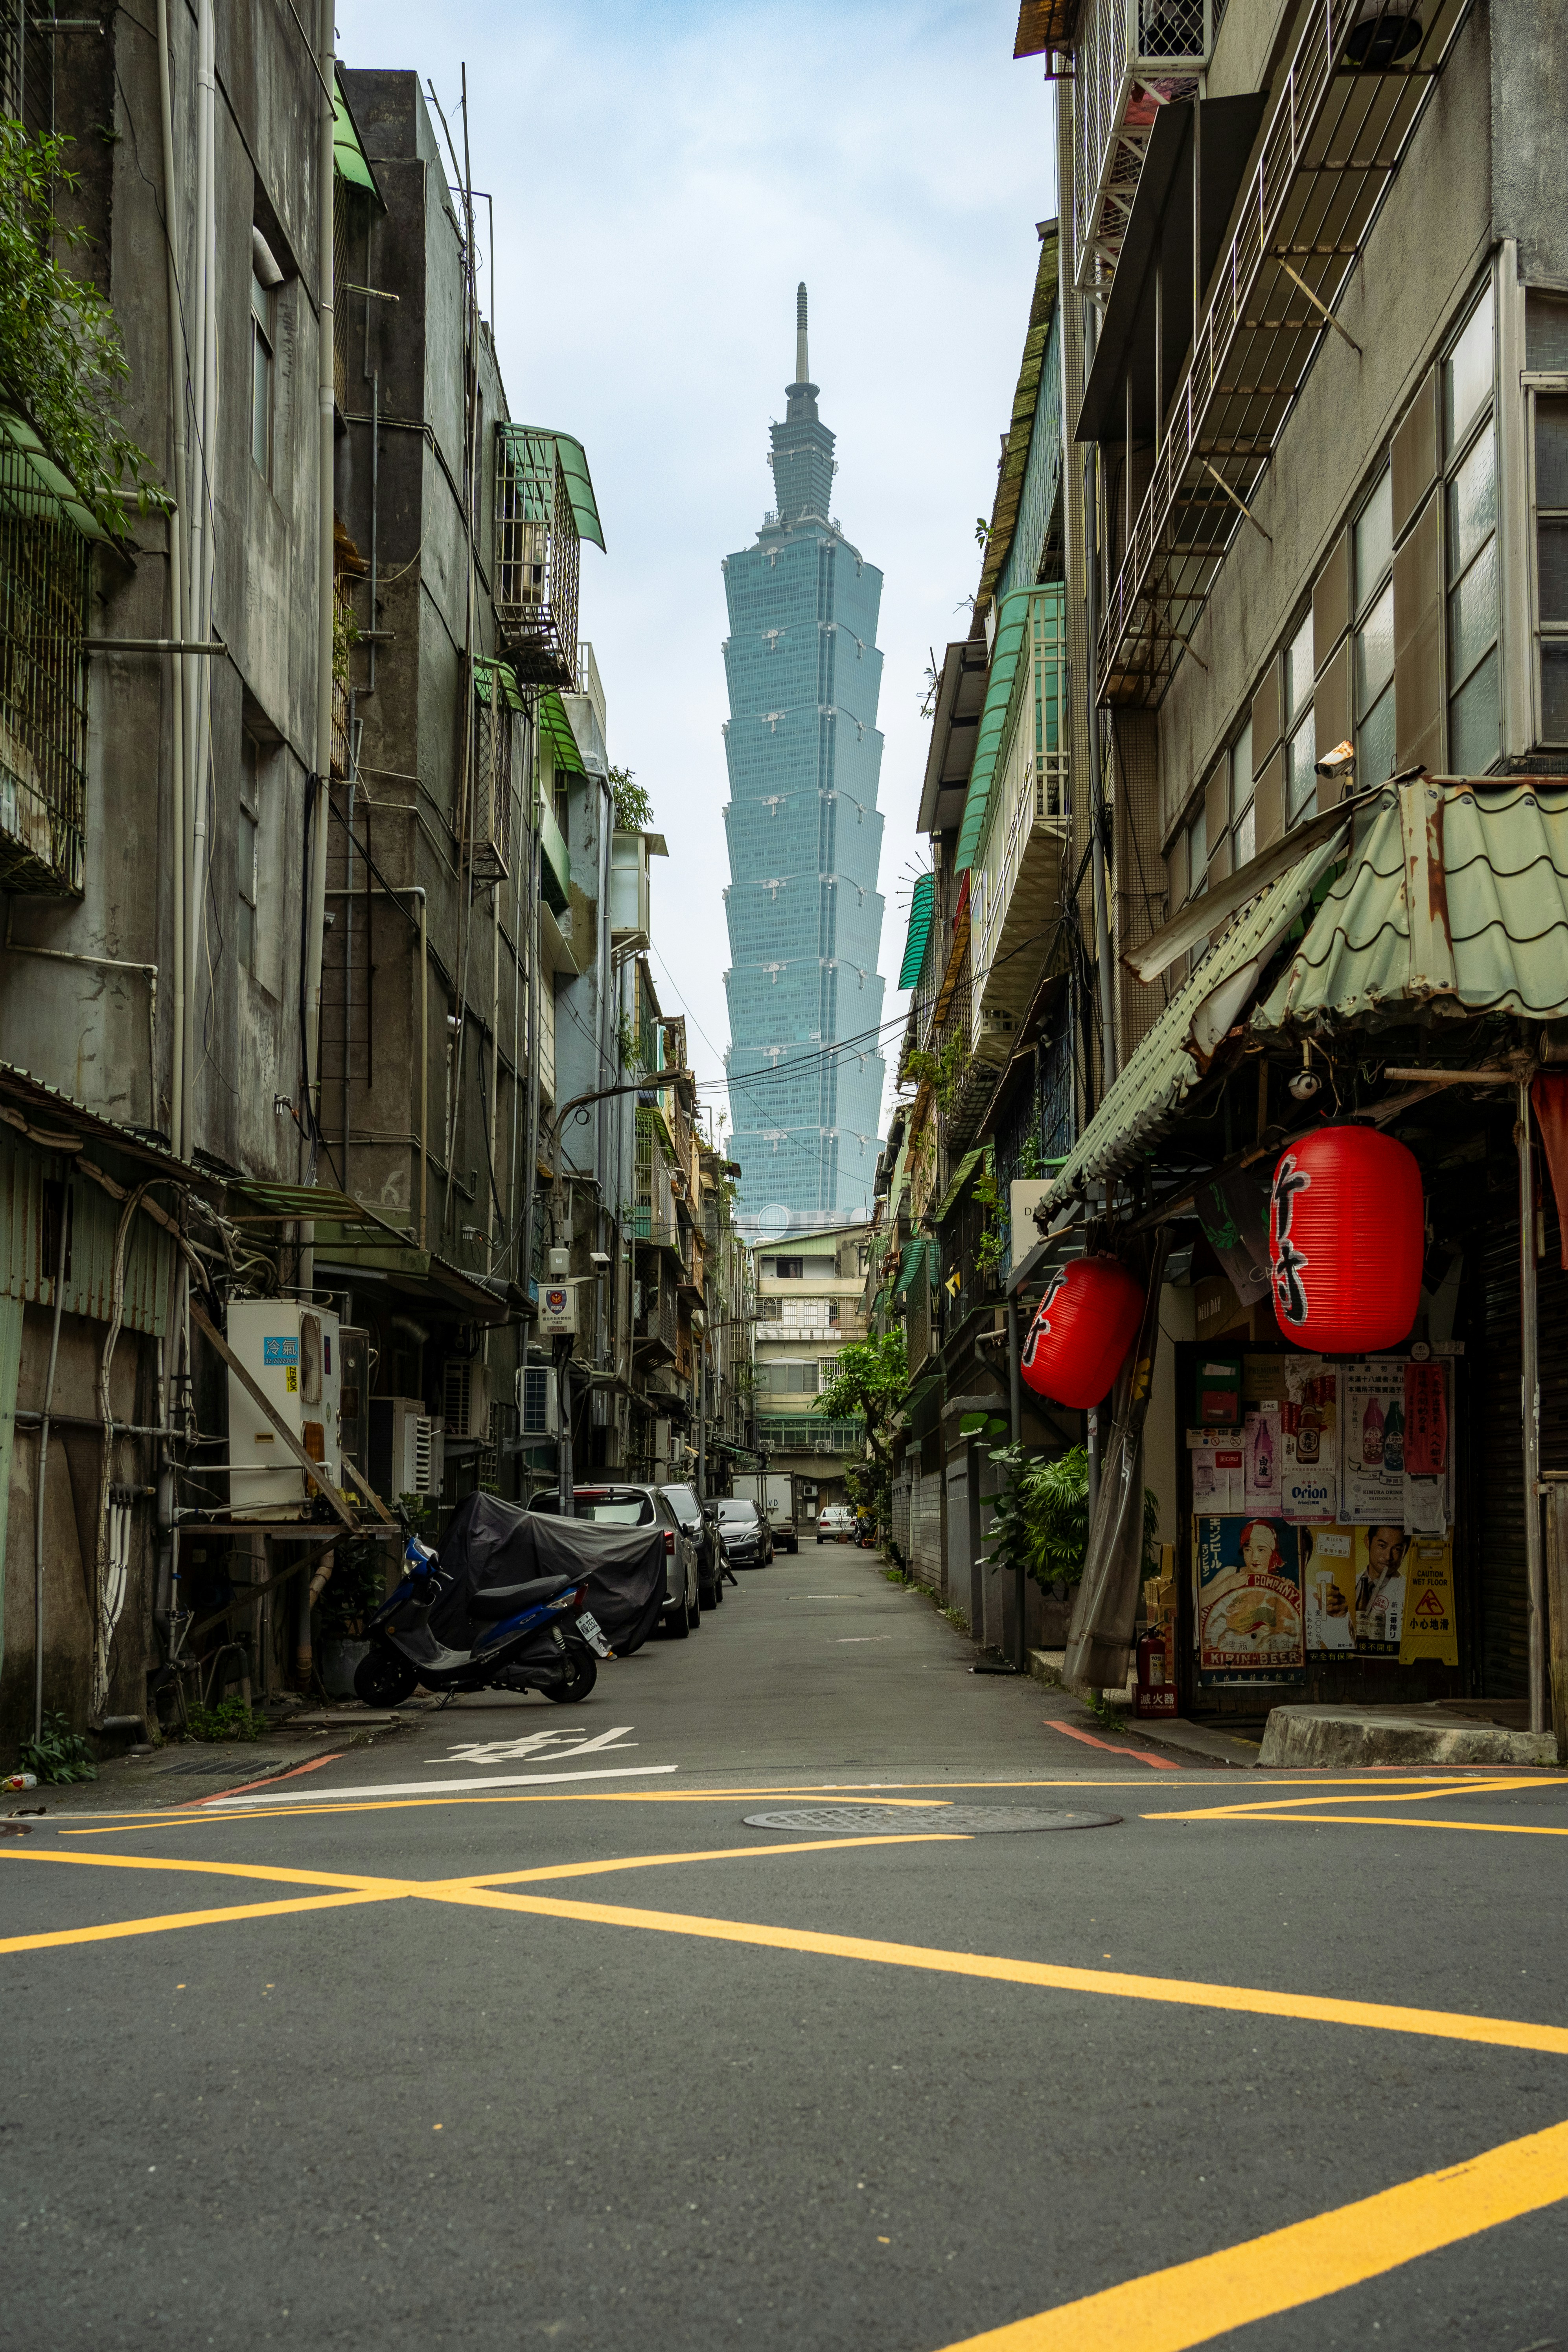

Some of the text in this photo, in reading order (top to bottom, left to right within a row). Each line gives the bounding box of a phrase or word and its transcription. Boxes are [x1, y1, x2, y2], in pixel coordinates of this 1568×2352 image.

[1198, 1296, 1221, 1321] DELI DAY
[266, 1339, 297, 1356] 冷氣
[1248, 1366, 1280, 1374] PREMIUM
[289, 1366, 297, 1391] ZEMOK
[1430, 1432, 1441, 1466] 人人都有
[1257, 1456, 1268, 1477] 白波
[1292, 1484, 1327, 1498] Orion
[1209, 1518, 1222, 1569] キリンビール
[1410, 1617, 1449, 1631] 小心地滑
[1357, 1642, 1394, 1652] 後不開車
[1310, 1652, 1355, 1661] 安全有保障
[1211, 1673, 1296, 1684] 未成年請勿飲酒
[1140, 1693, 1174, 1704] 滅火器
